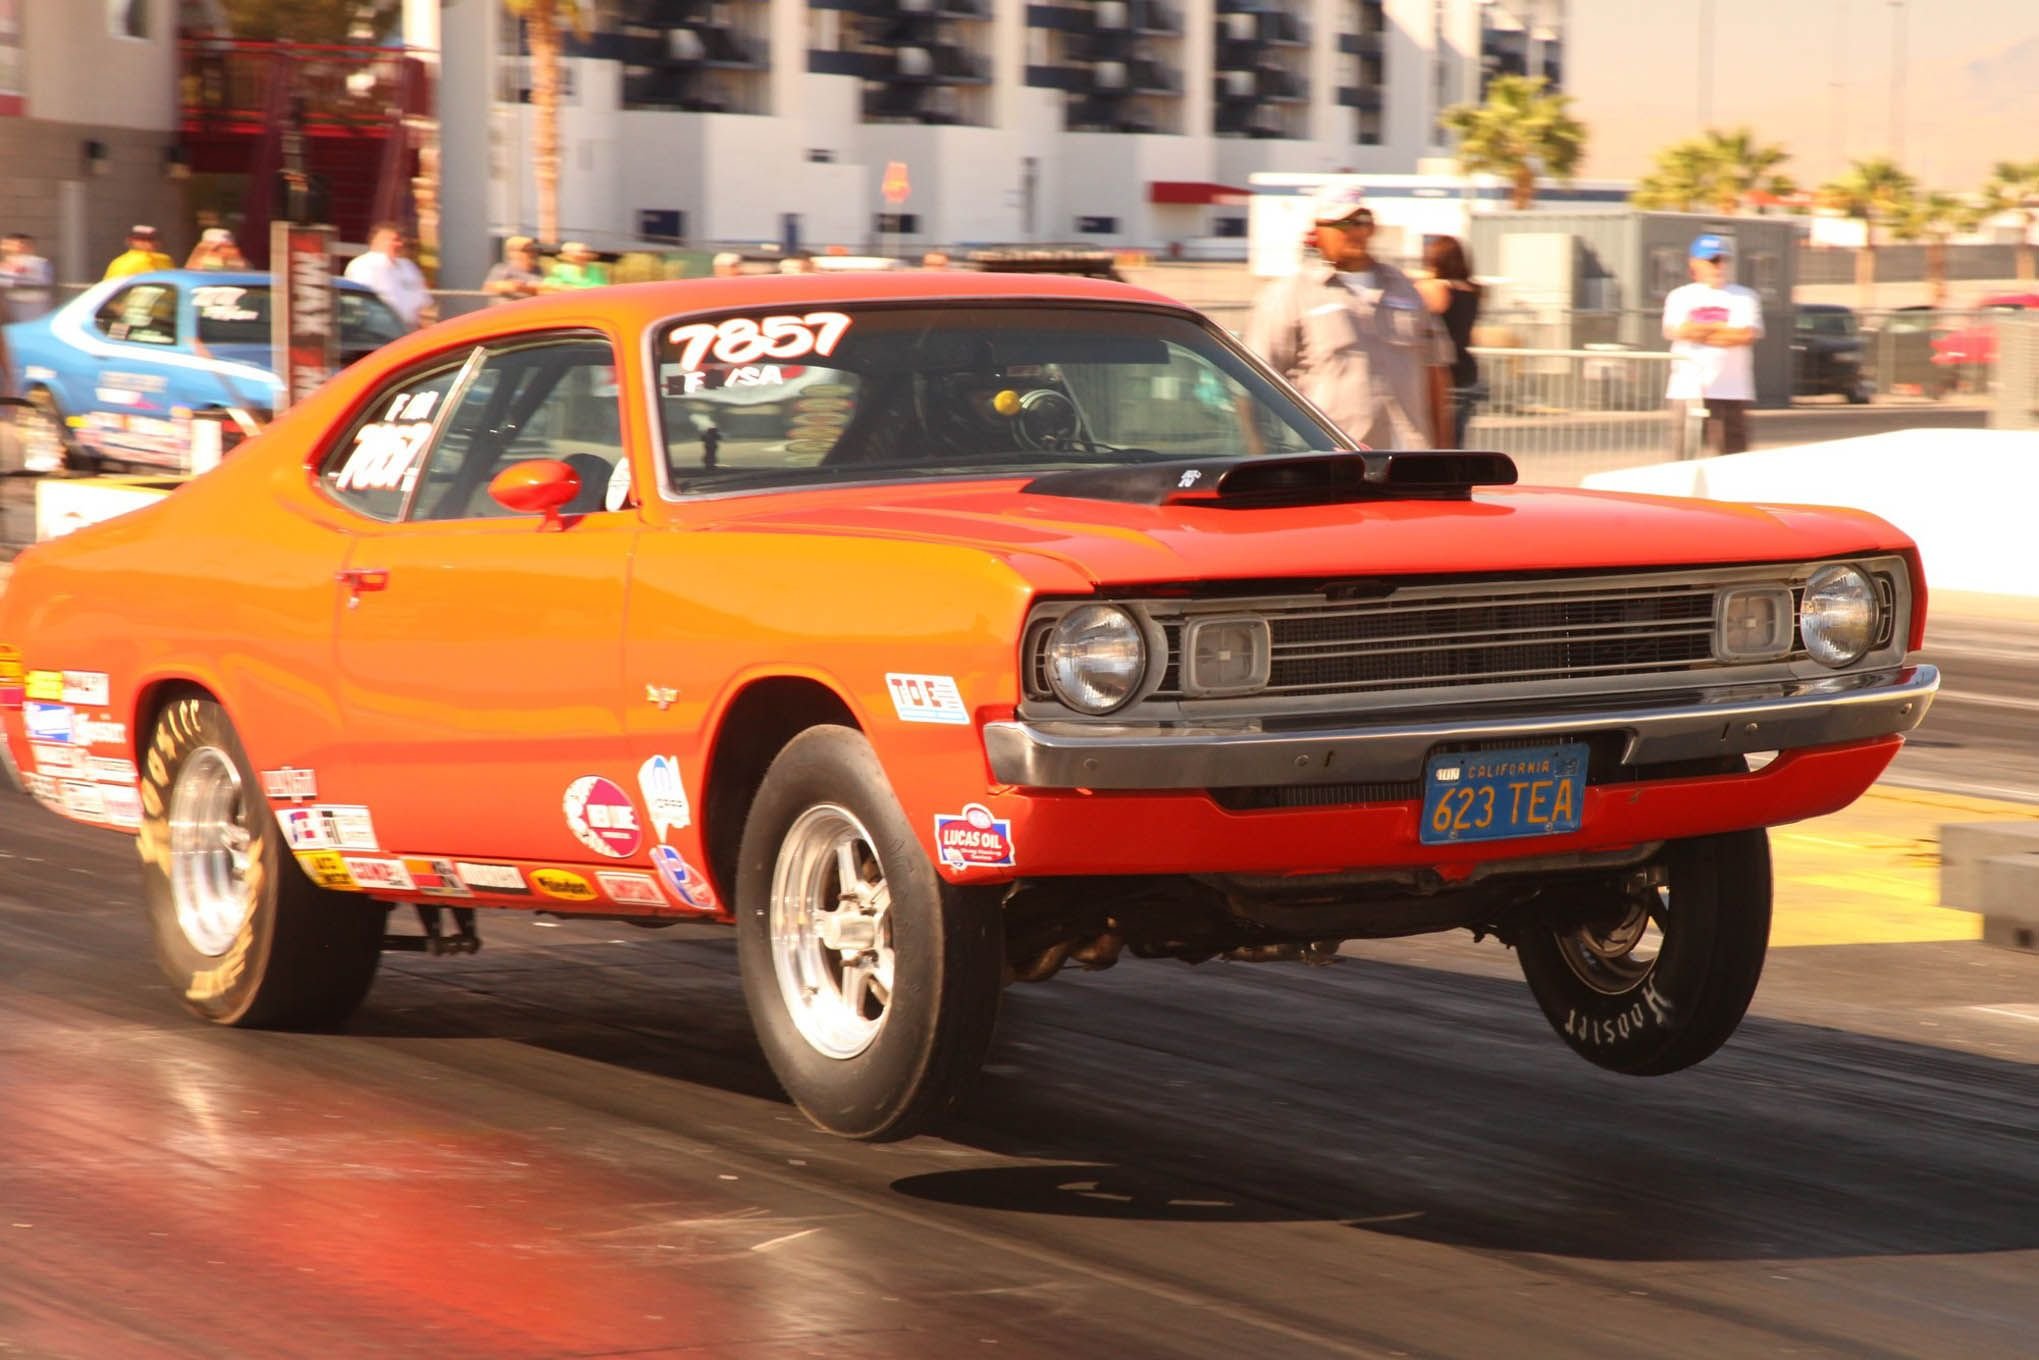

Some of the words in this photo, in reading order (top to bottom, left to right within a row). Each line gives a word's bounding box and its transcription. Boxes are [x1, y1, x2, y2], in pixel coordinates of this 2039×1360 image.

[669, 311, 853, 371] 7857
[1467, 760, 1551, 779] CALIFORNIA
[1432, 786, 1496, 832] 623
[1508, 778, 1573, 825] TEA
[943, 829, 980, 847] LUCAS
[981, 833, 1003, 849] OIL
